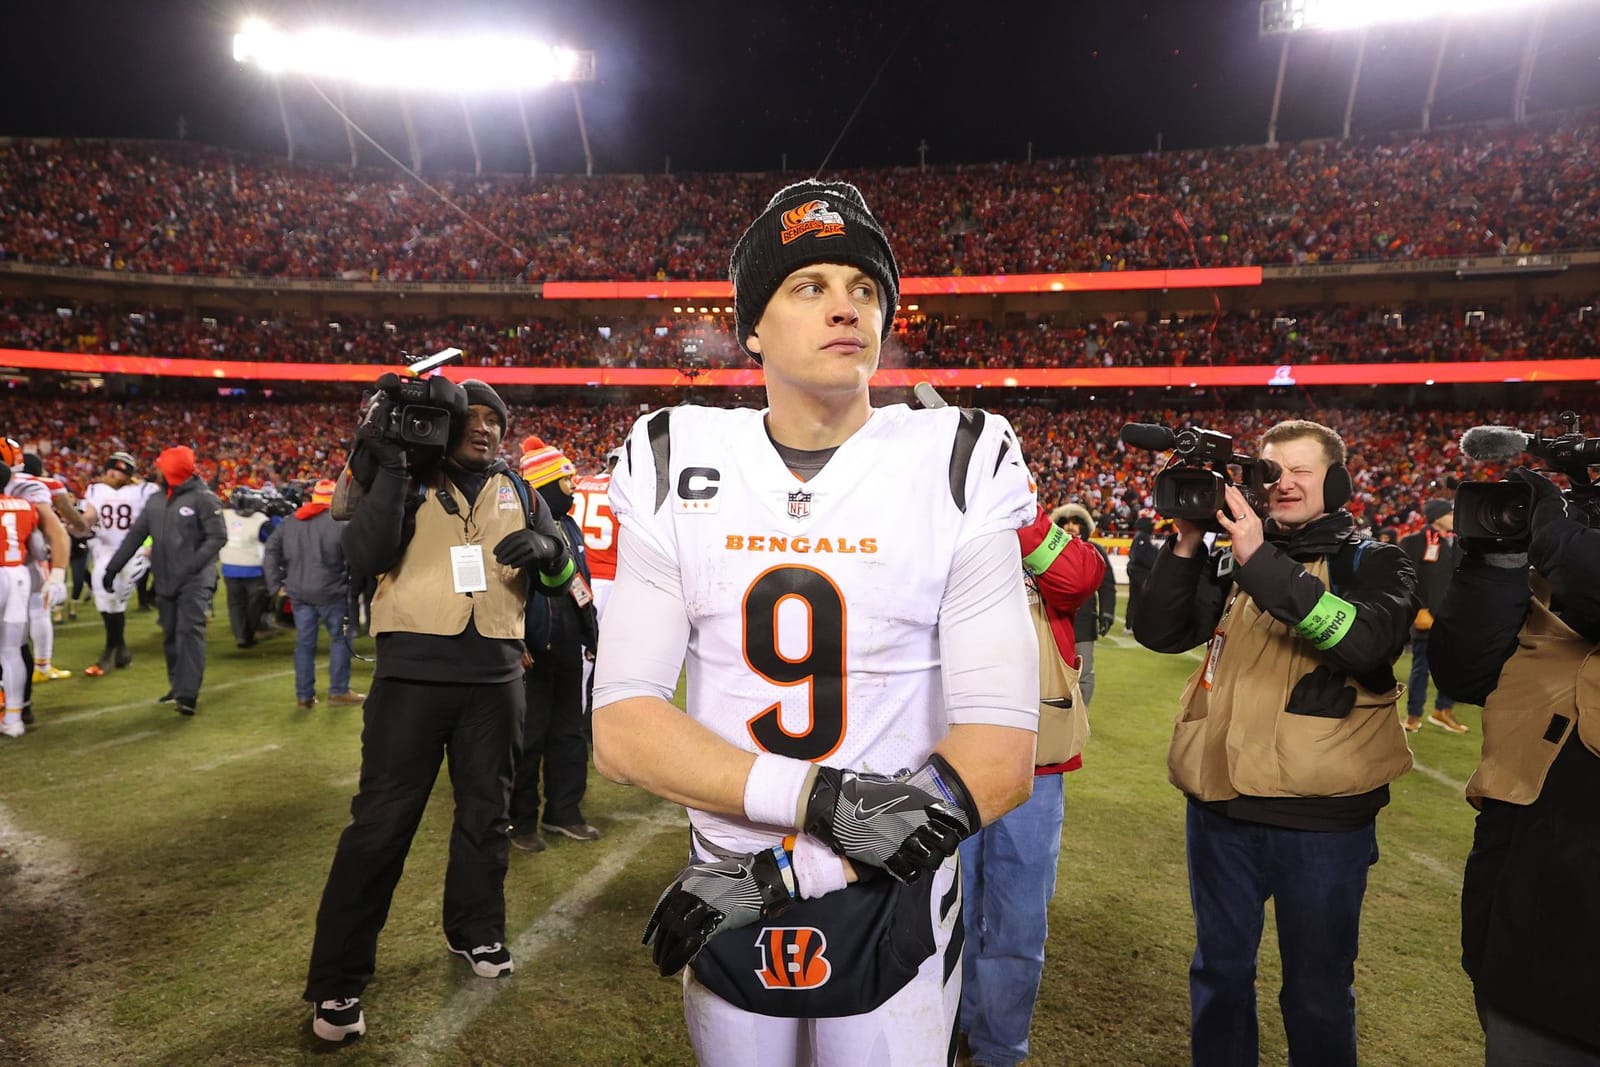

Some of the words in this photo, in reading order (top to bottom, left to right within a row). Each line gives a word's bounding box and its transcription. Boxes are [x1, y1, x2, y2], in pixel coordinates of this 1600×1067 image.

[677, 467, 721, 500] C
[100, 503, 132, 530] 88
[789, 501, 809, 515] NFL
[725, 534, 879, 553] BENGALS
[741, 563, 848, 764] 9
